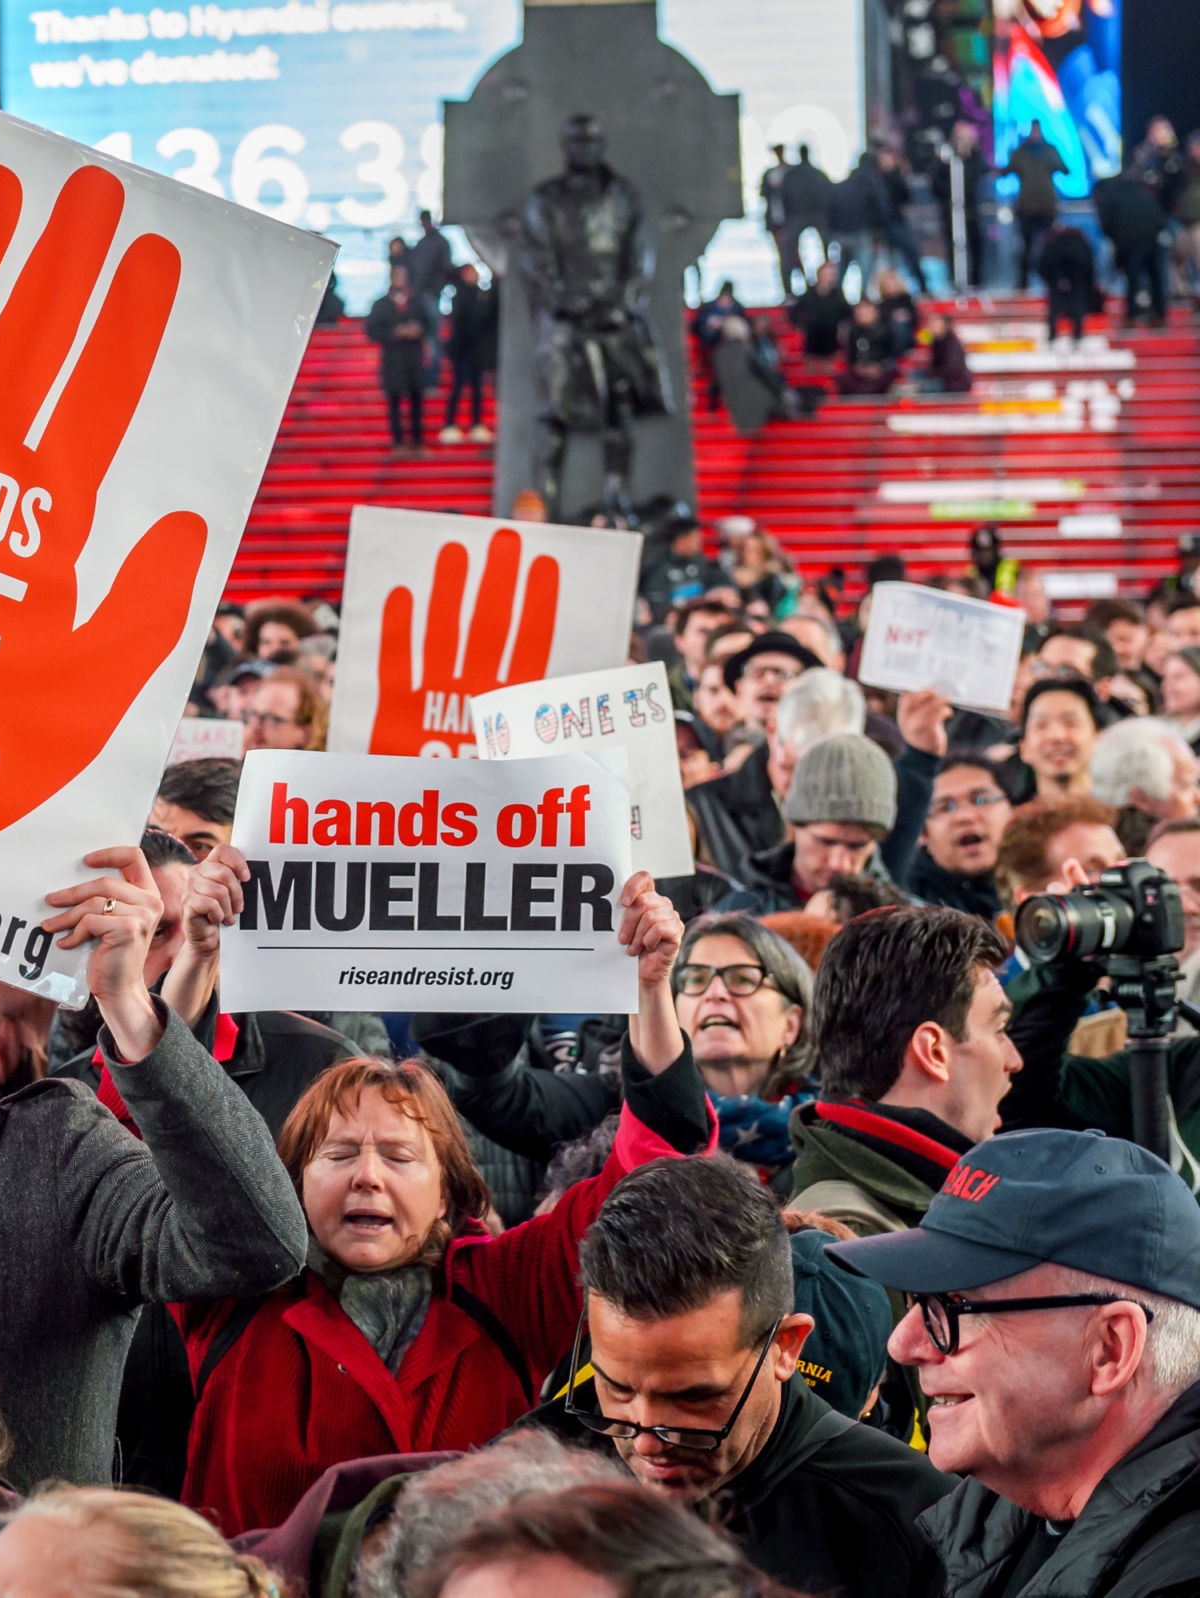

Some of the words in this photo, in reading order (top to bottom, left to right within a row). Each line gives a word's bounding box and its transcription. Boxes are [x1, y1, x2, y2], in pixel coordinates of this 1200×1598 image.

[422, 690, 476, 735] HAN
[534, 693, 615, 744] ONE
[622, 682, 665, 727] IS
[269, 782, 478, 848] hands
[496, 784, 591, 848] off
[239, 860, 615, 932] MUELLER
[338, 966, 514, 990] riseandresist.org
[796, 1359, 833, 1383] RNIA
